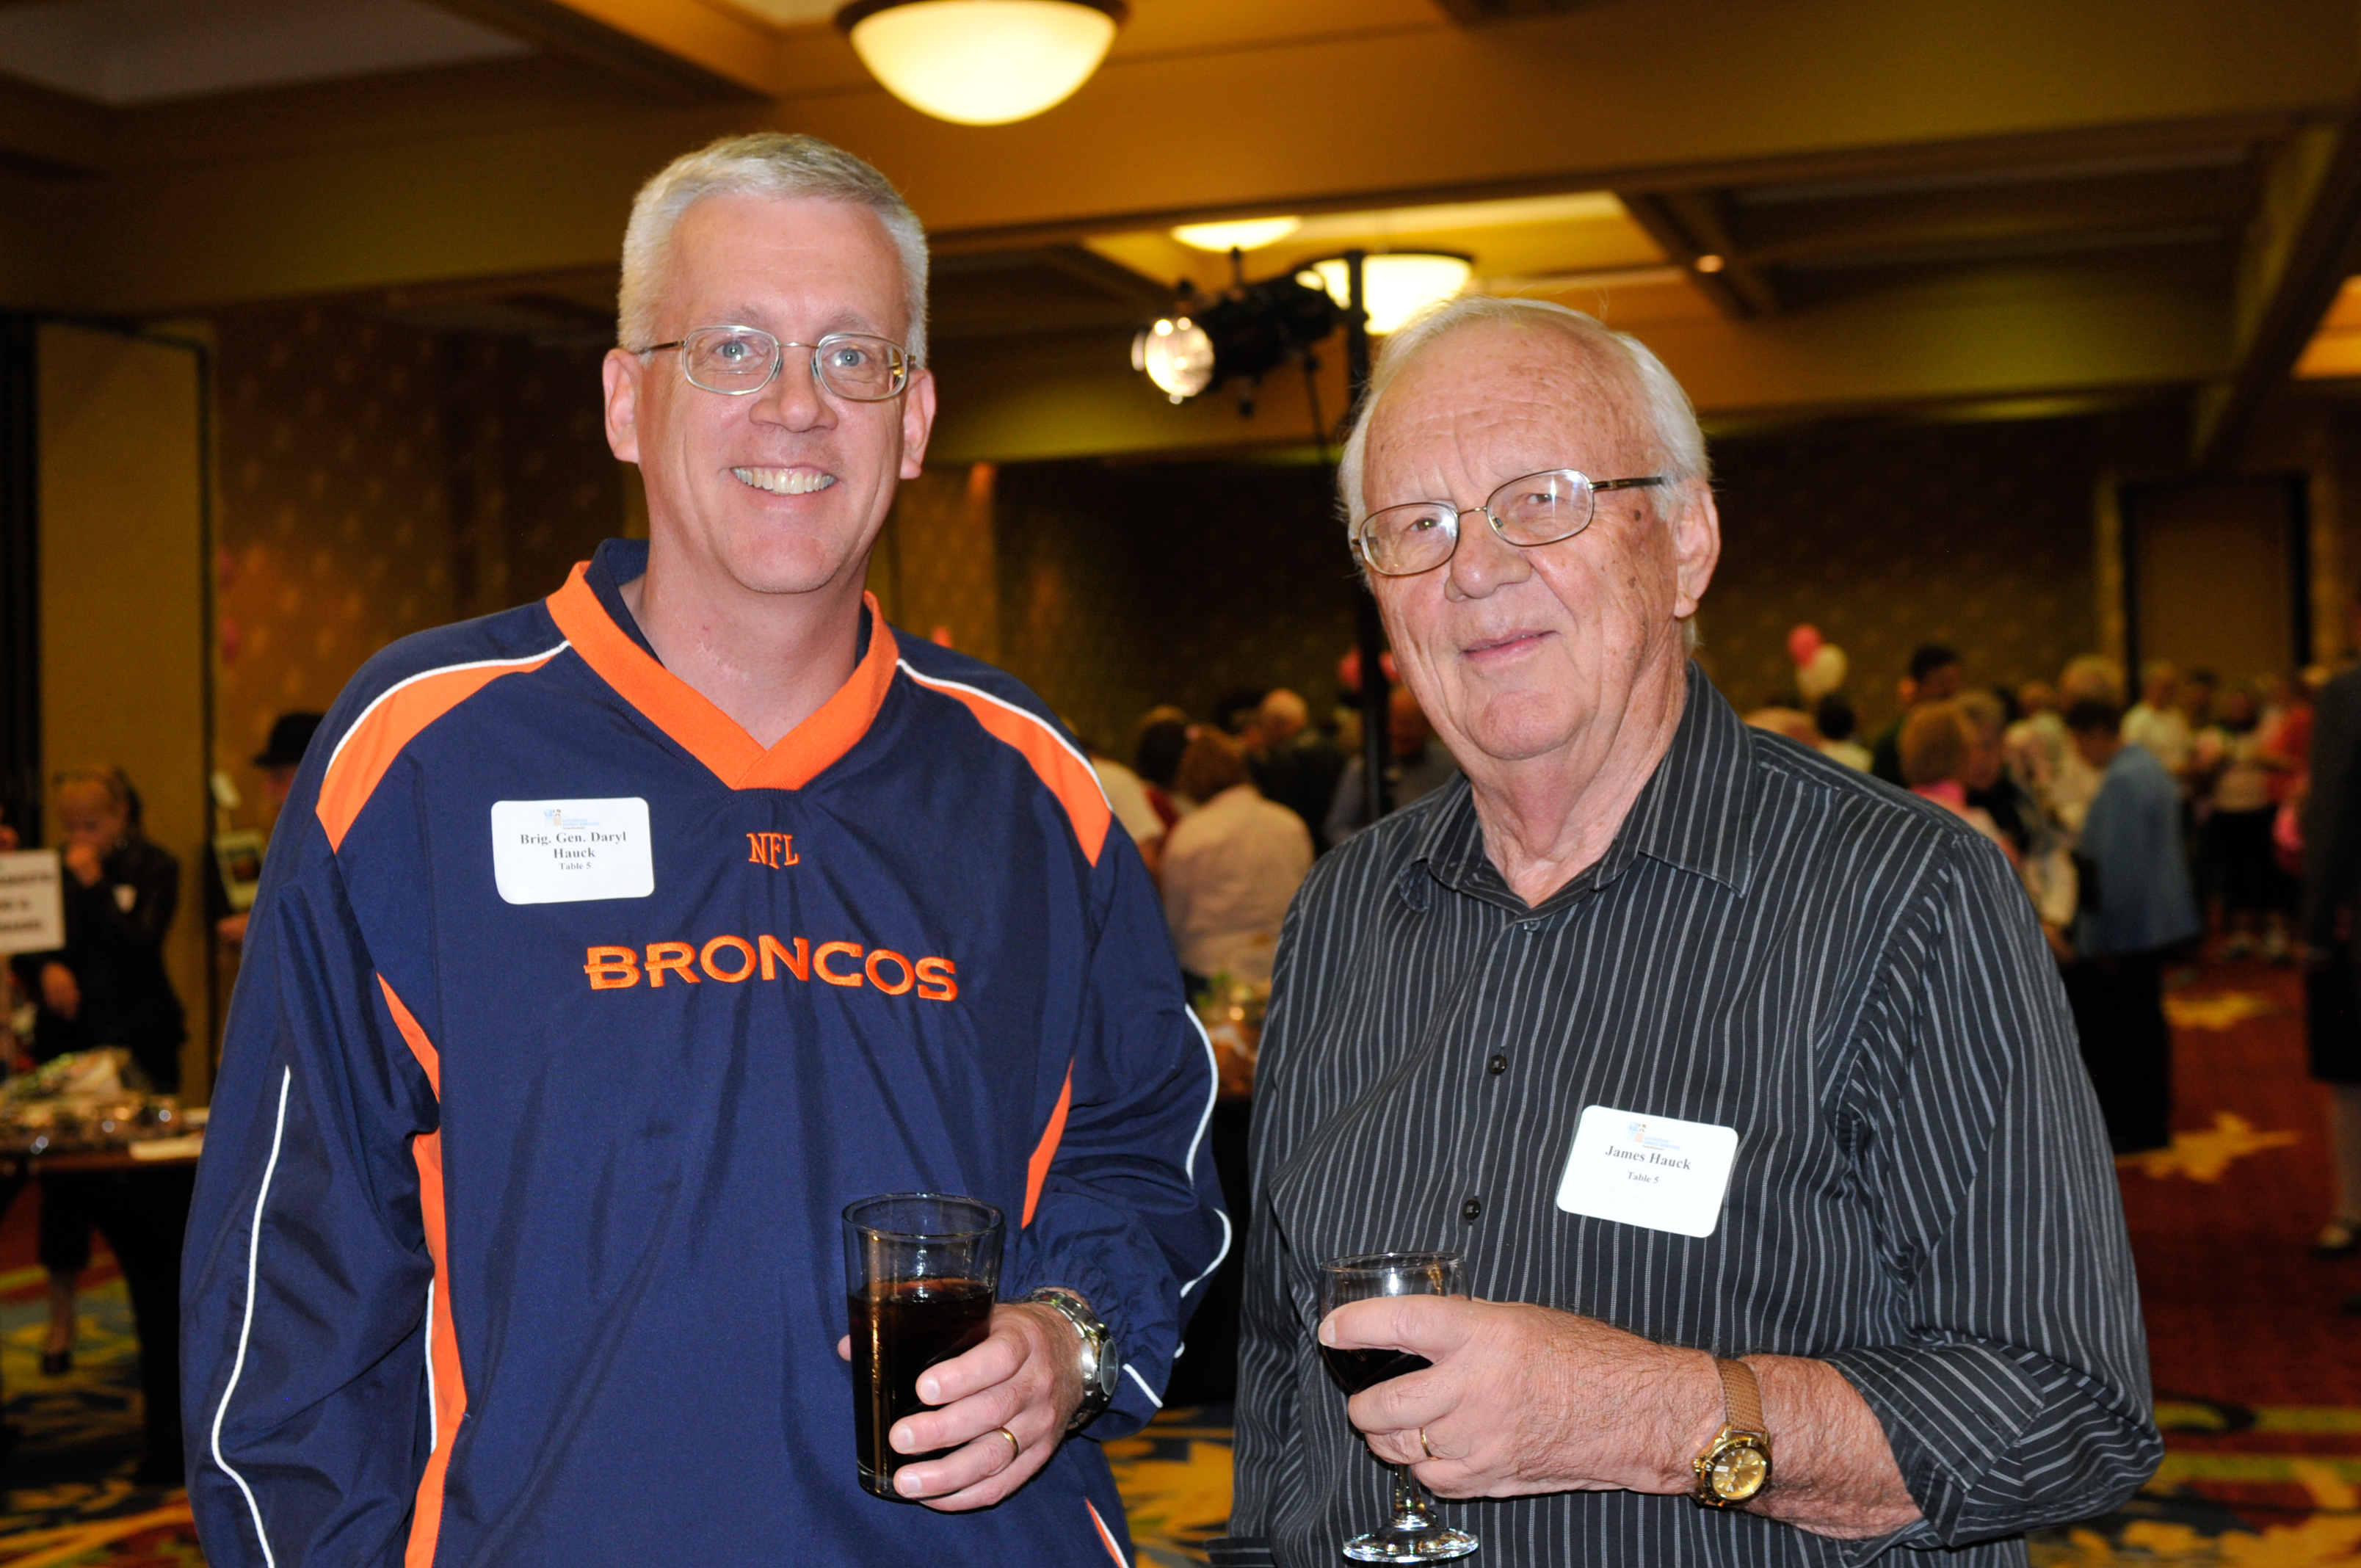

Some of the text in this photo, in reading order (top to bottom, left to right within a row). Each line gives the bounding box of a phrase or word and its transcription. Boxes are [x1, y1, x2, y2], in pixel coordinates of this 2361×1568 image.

[520, 832, 626, 846] Brig. Gen. Daryl
[553, 847, 595, 859] Hauck
[746, 832, 801, 870] NFL
[558, 862, 592, 871] Table 5
[584, 934, 959, 1001] BRONCOS
[1605, 1145, 1691, 1170] James Hauck
[1627, 1171, 1659, 1184] Table 5
